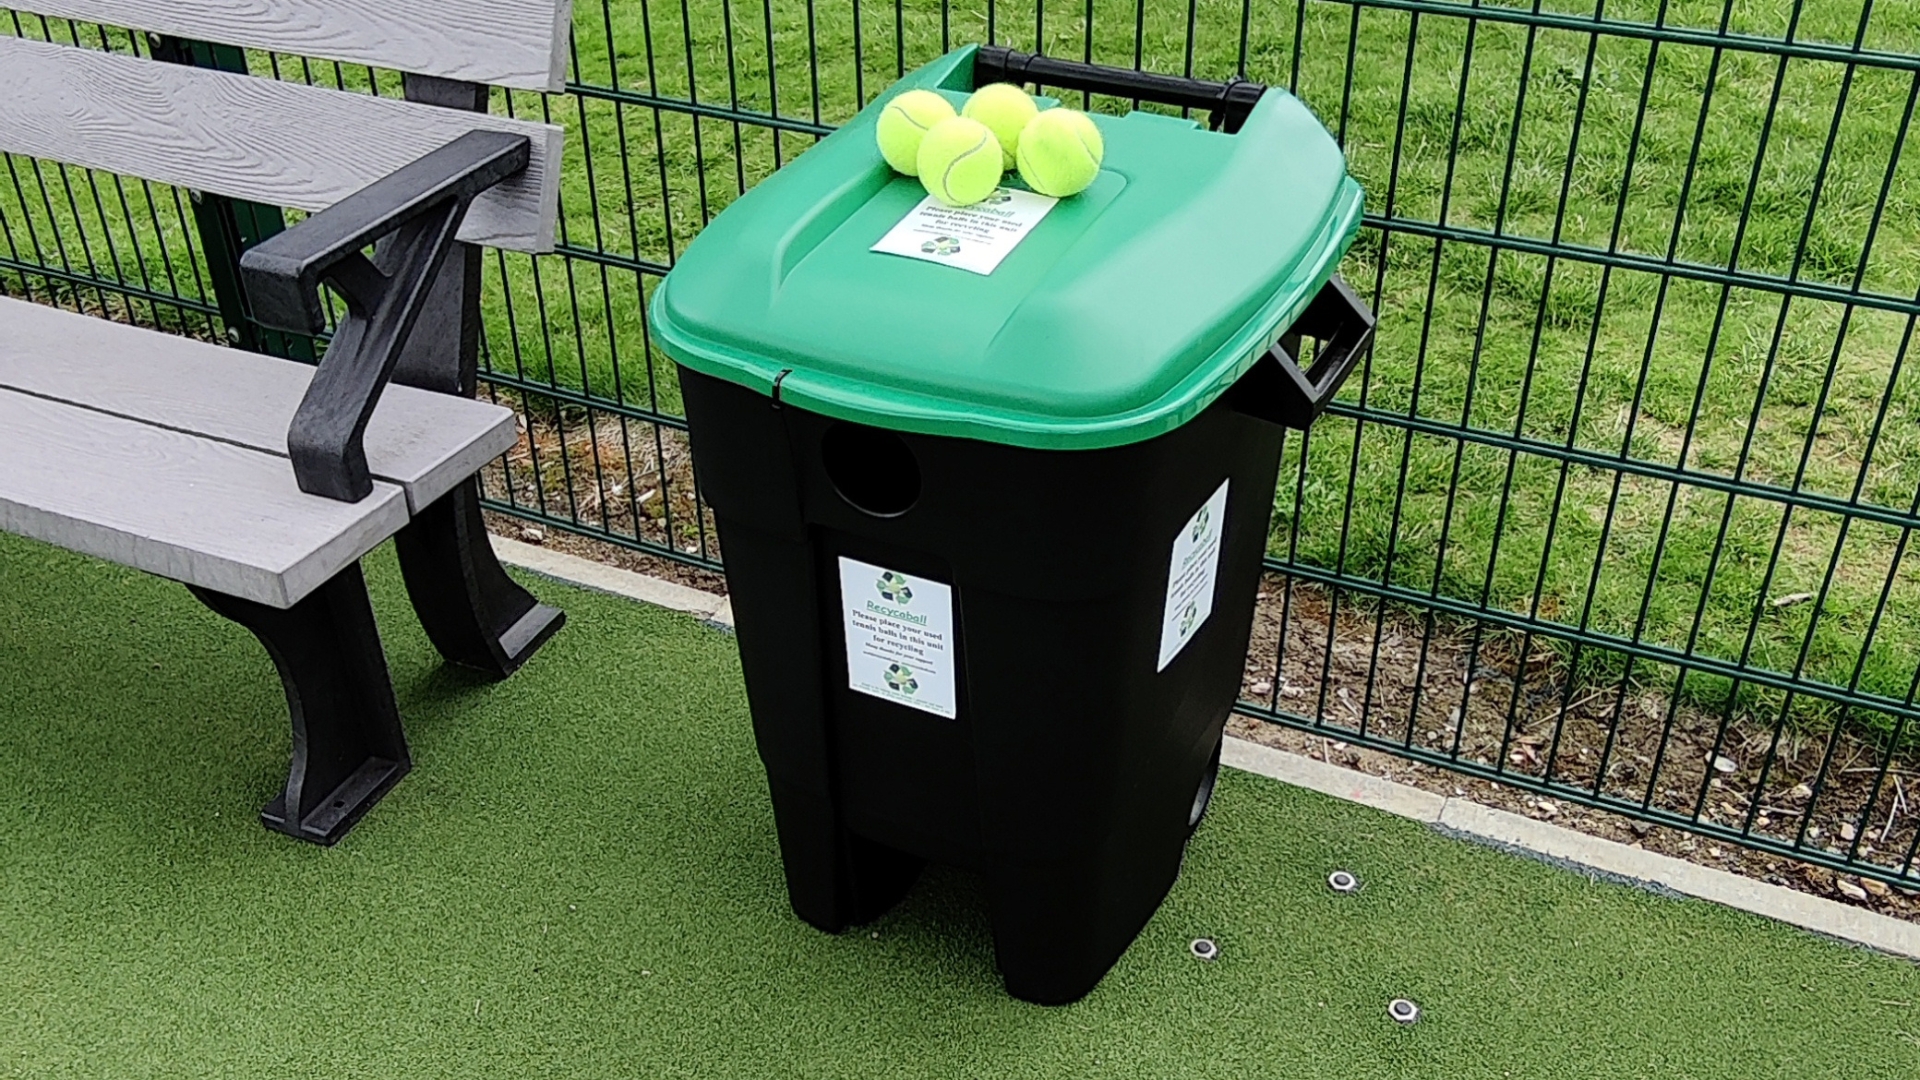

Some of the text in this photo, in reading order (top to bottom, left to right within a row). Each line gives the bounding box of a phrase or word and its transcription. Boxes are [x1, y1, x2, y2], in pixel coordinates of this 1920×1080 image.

[852, 609, 943, 641] Please place your used
[866, 600, 927, 626] Recycaball
[852, 620, 943, 651] tennis balls in this unit
[873, 634, 924, 656] for recycling
